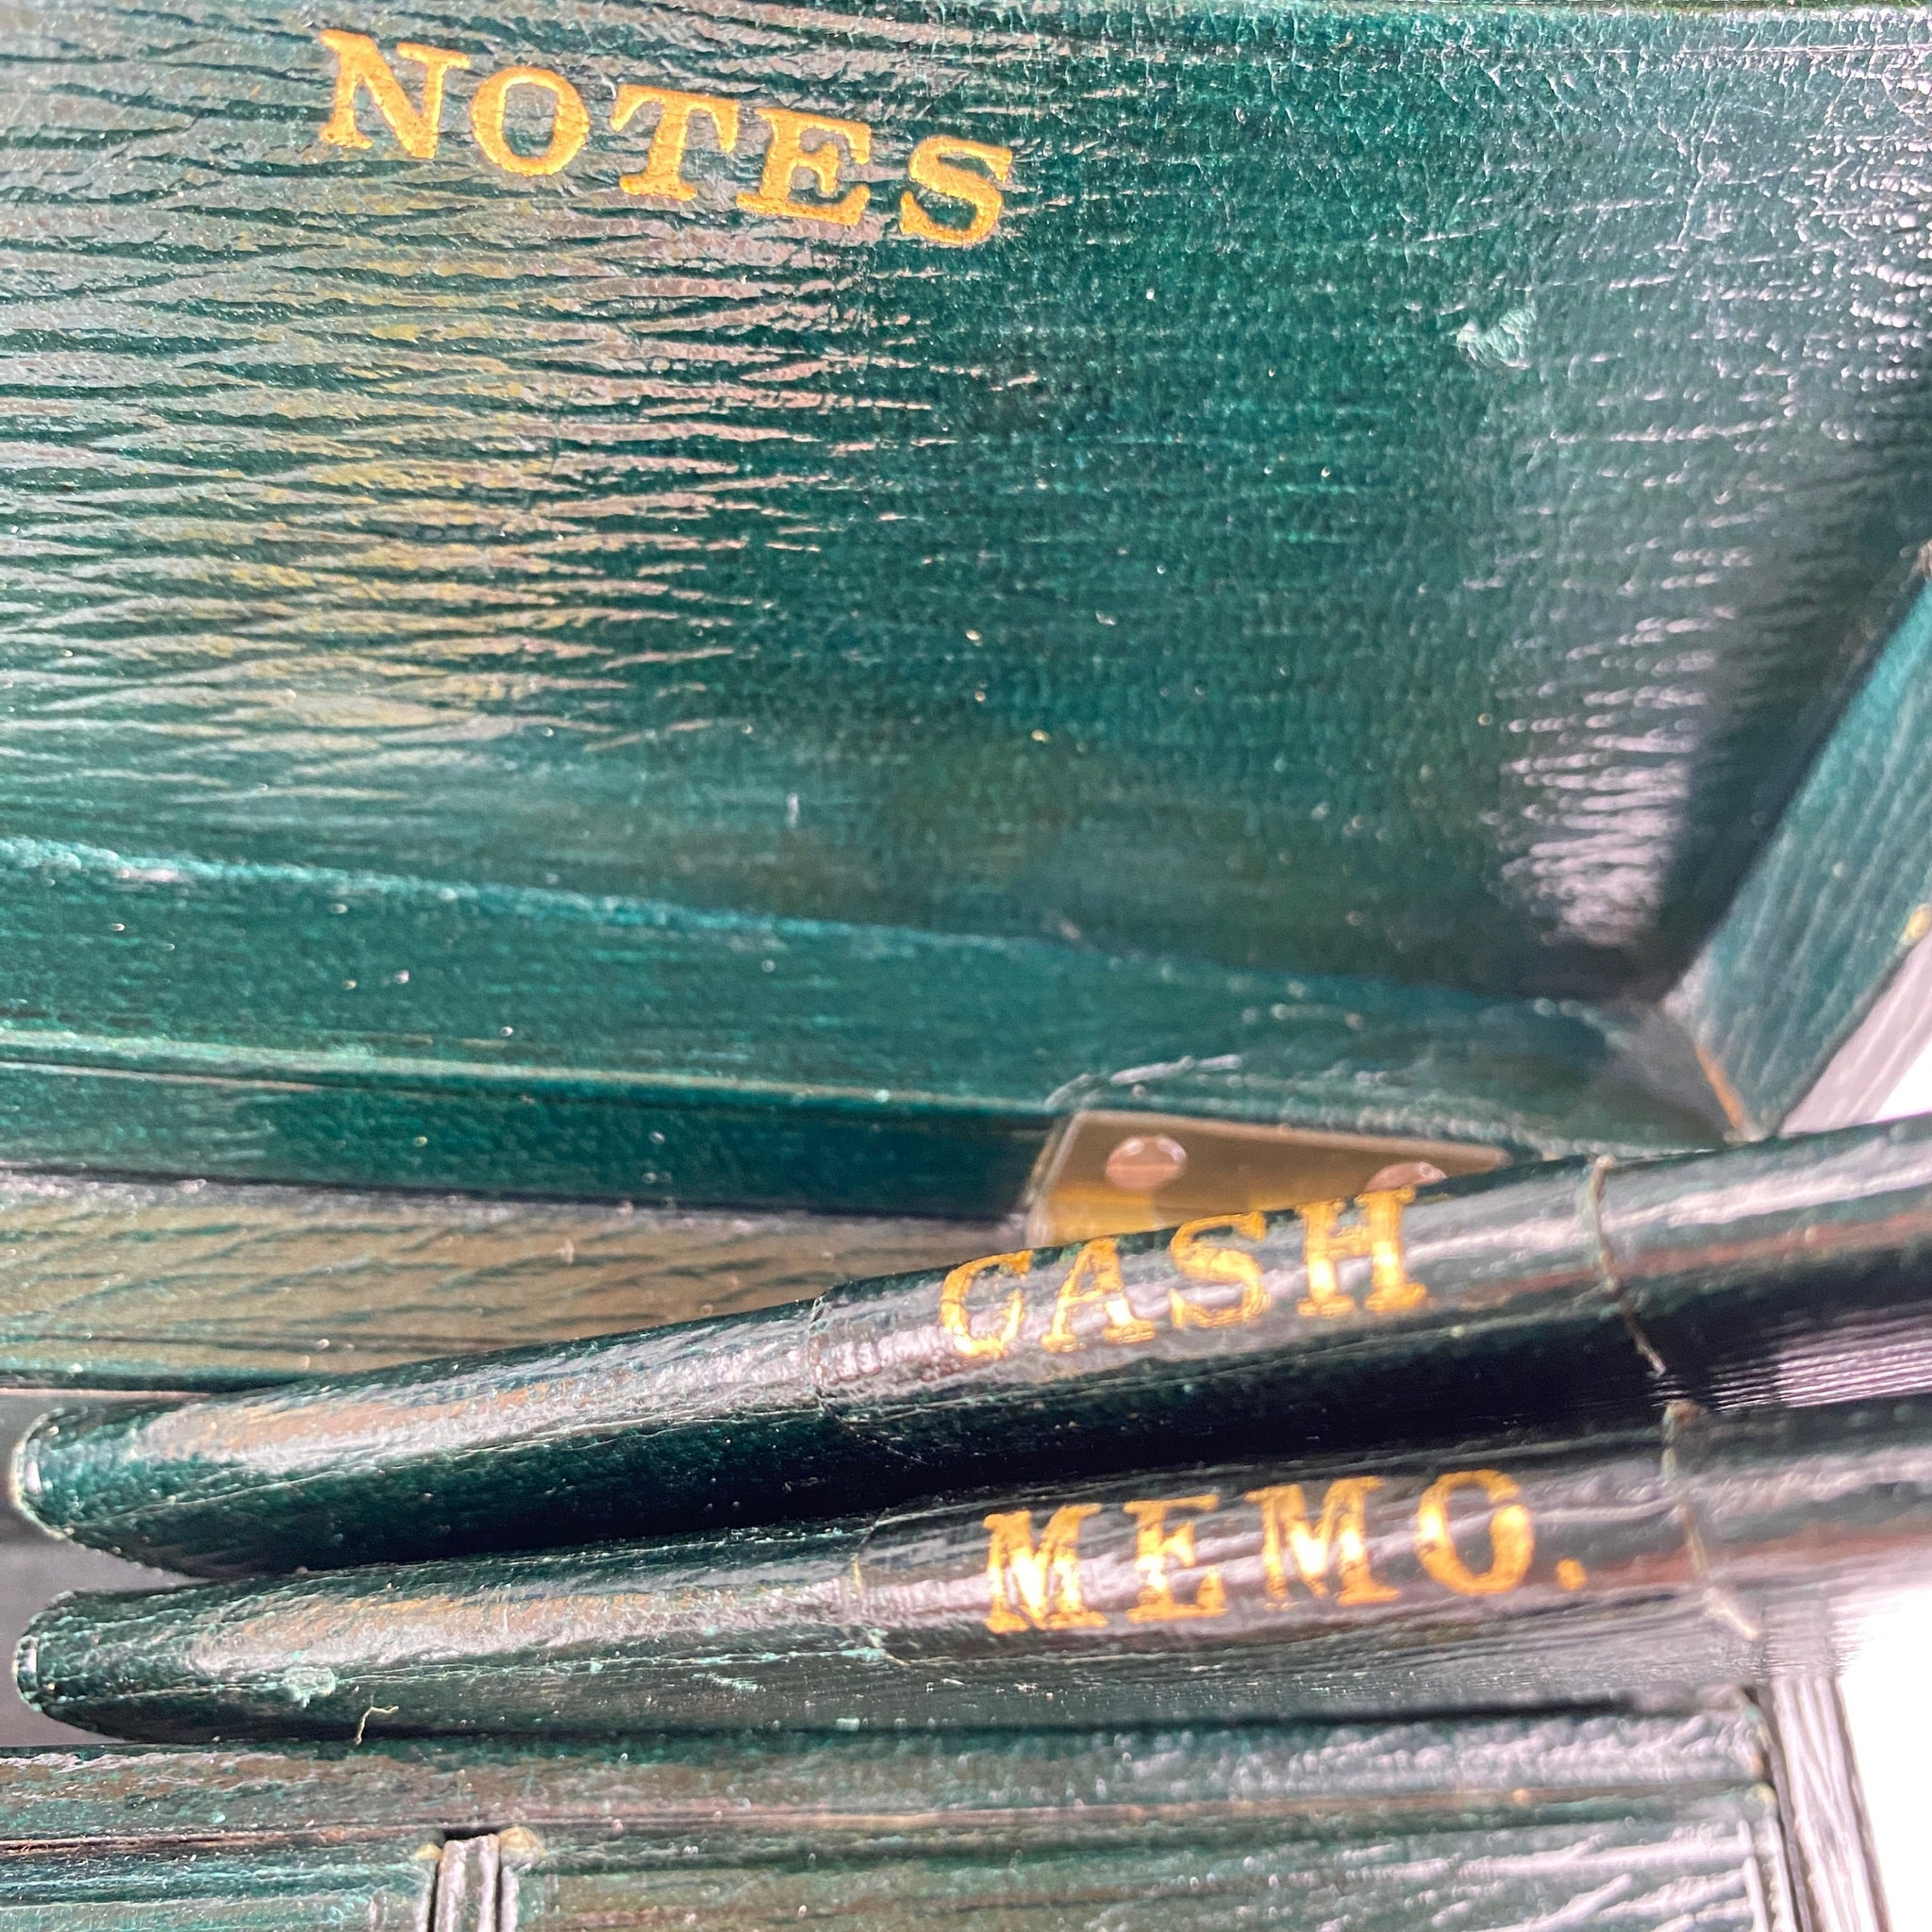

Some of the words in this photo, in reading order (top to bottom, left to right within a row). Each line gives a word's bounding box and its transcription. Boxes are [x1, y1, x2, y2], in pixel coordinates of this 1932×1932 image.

[319, 28, 1014, 248] NOTES
[940, 1187, 1430, 1358] CASH
[983, 1469, 1588, 1634] MEMO.
